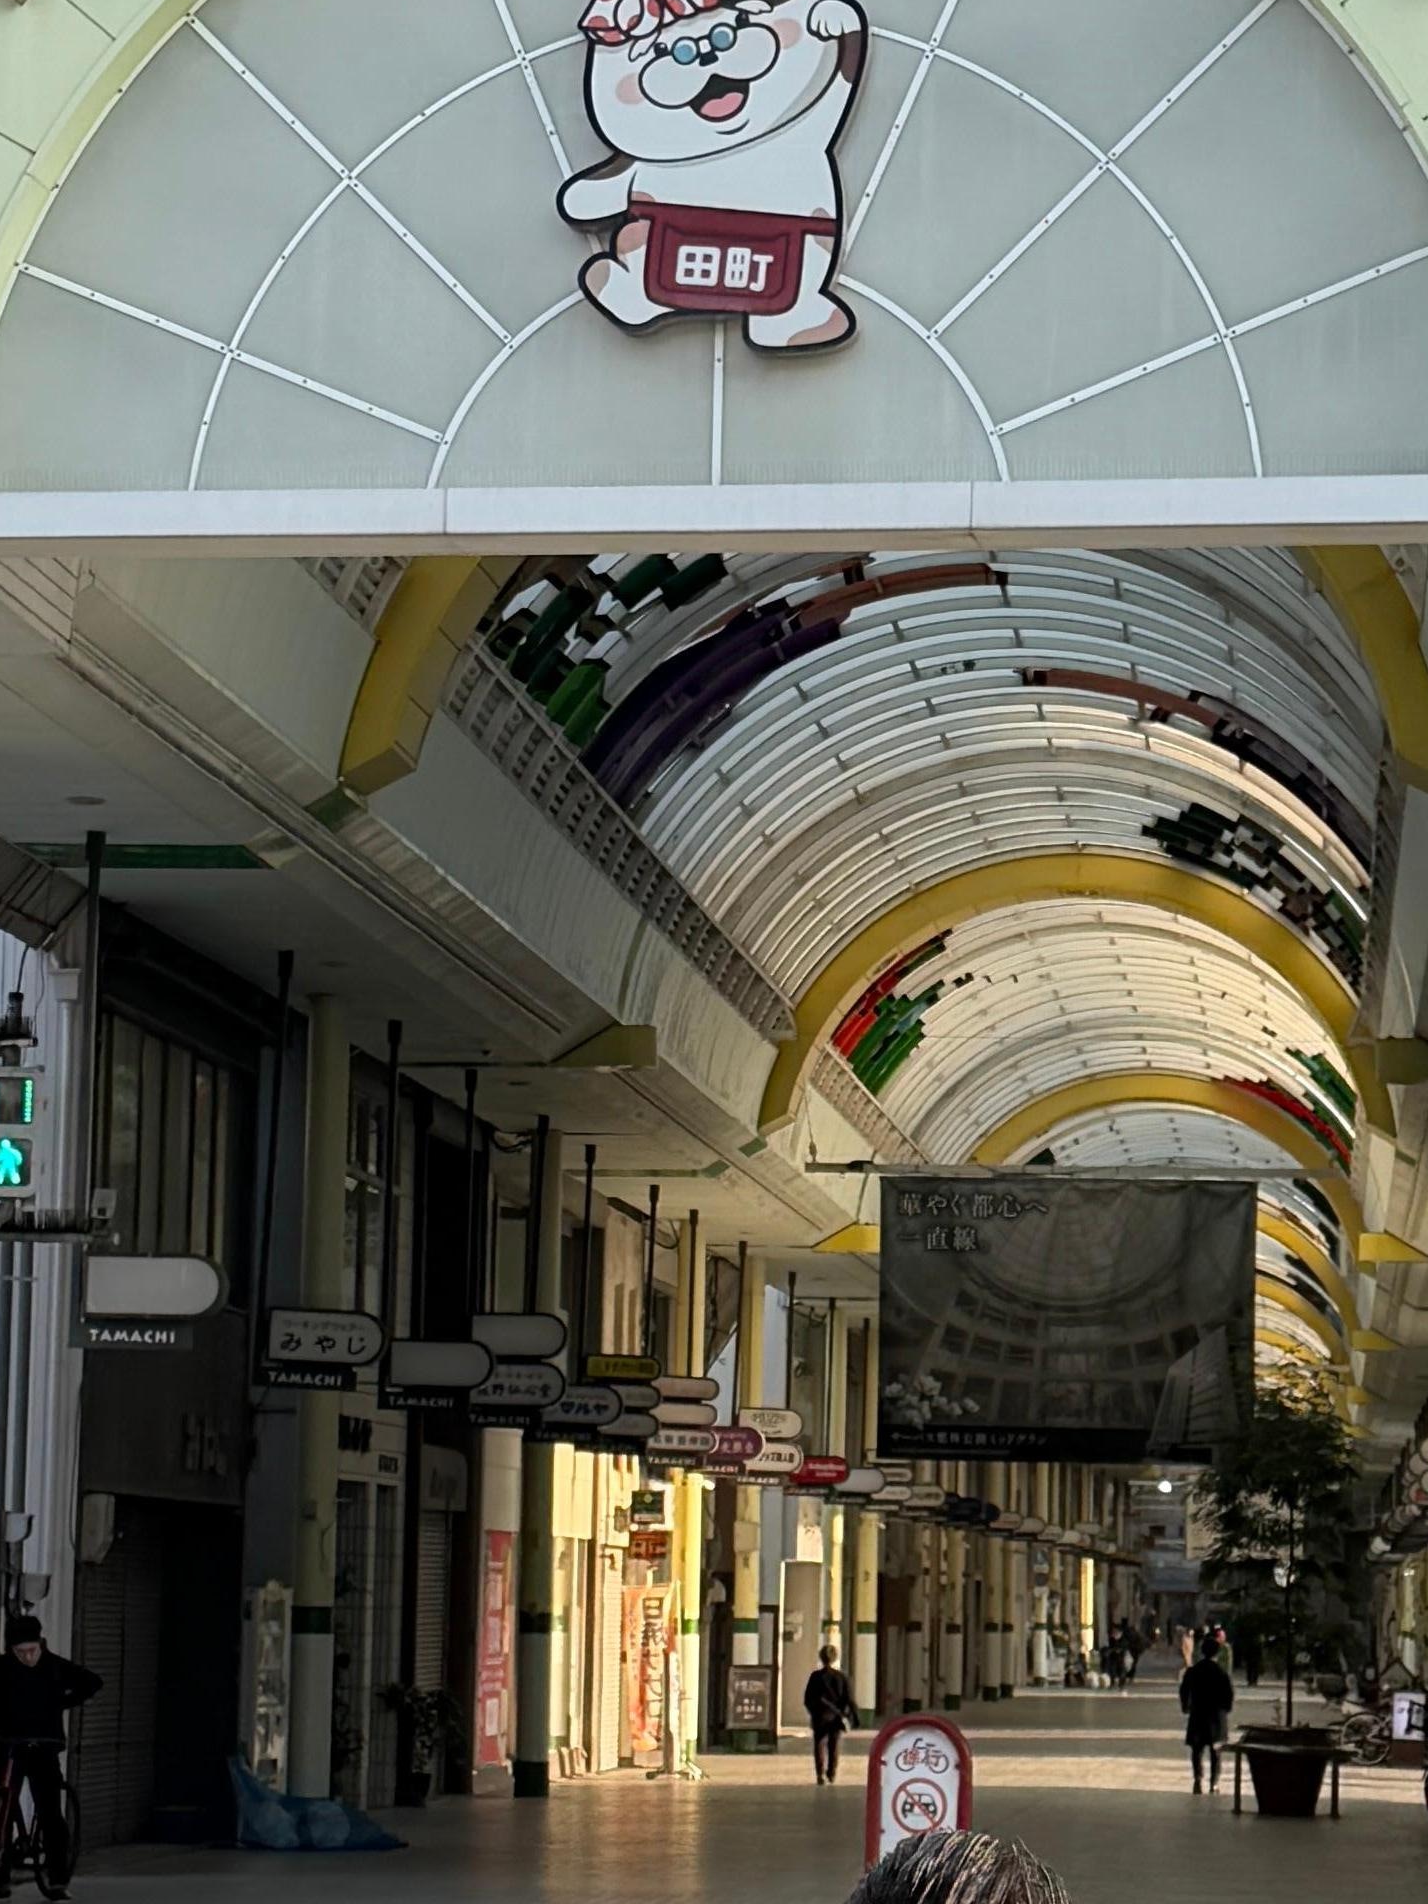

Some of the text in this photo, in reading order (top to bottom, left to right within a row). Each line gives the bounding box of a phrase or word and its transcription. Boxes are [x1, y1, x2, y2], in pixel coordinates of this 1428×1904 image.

[675, 245, 774, 292] 田町
[897, 1226, 980, 1251] 一直線
[89, 1328, 176, 1344] TAMACHI
[280, 1333, 366, 1355] みやじ
[268, 1371, 343, 1387] TAMACHI
[388, 1396, 455, 1408] TAMACHI
